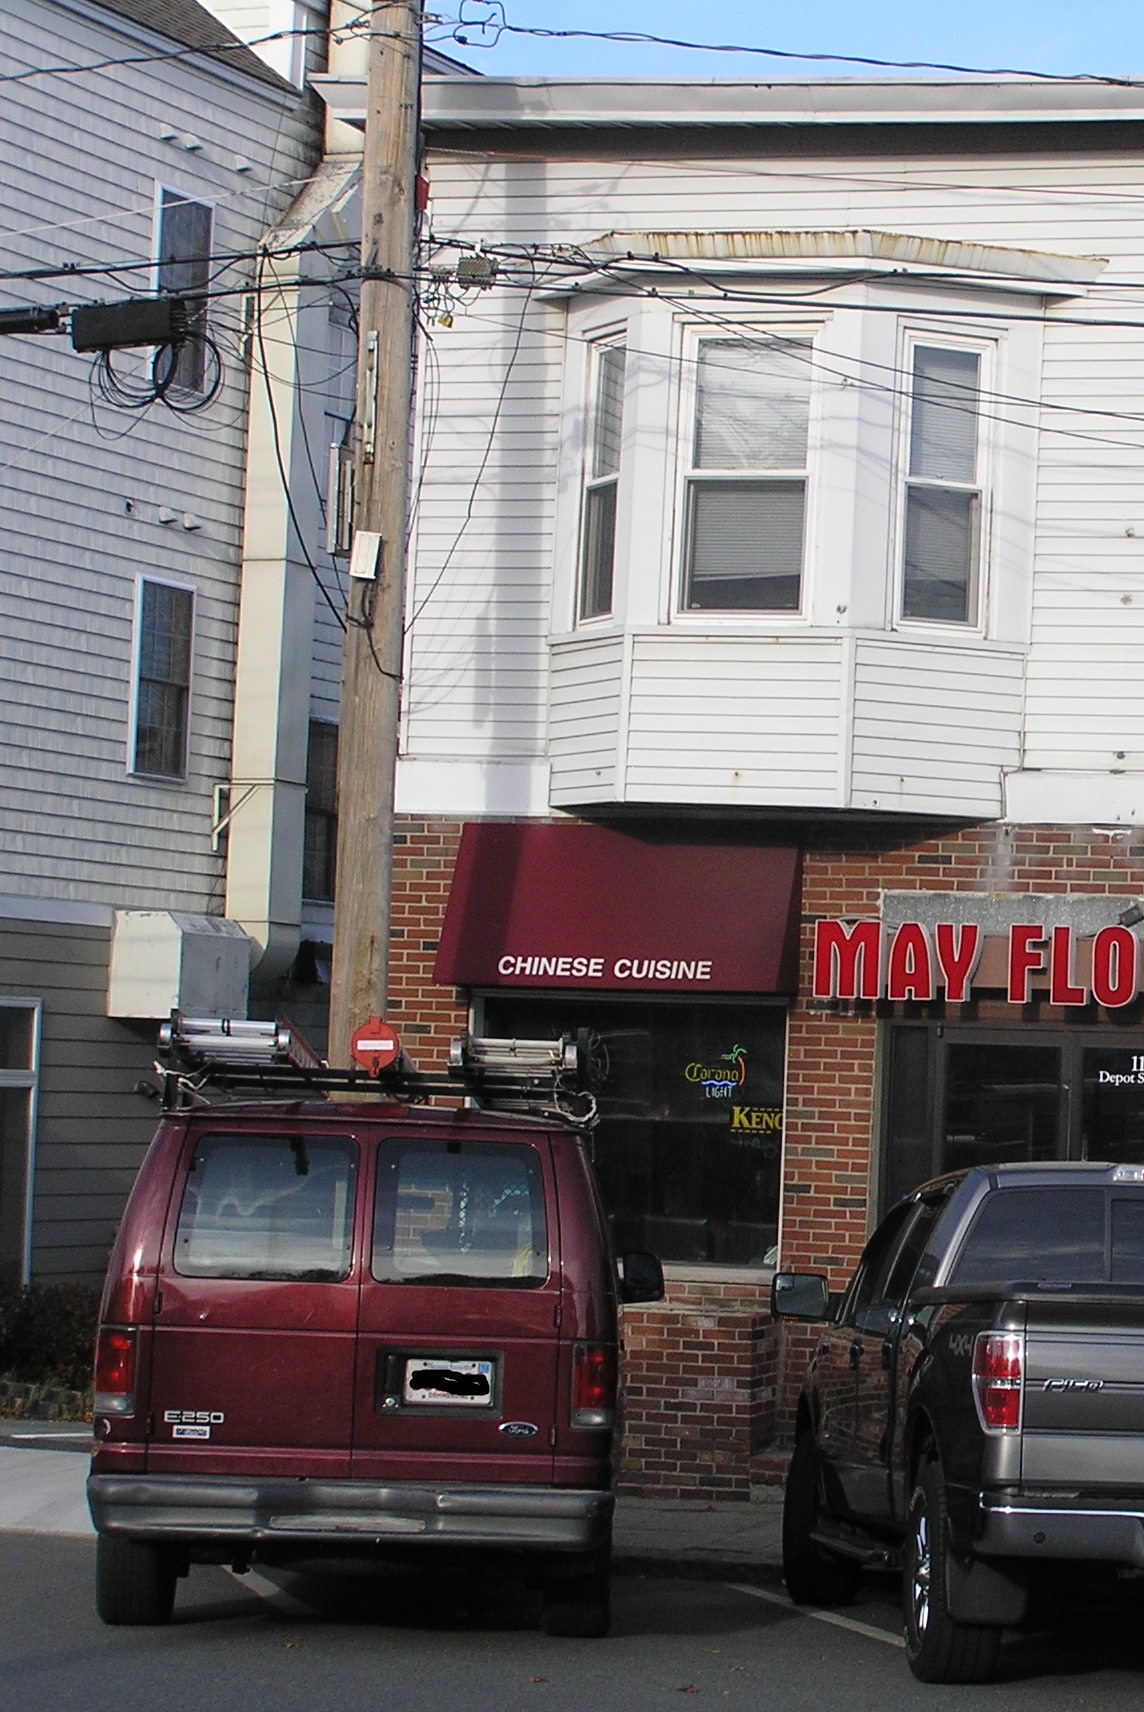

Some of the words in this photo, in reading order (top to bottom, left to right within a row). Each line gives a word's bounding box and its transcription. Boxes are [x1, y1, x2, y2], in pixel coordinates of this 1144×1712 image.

[498, 955, 604, 978] CHINESE
[613, 959, 712, 980] CUISINE
[813, 919, 981, 1002] MAY
[684, 1062, 739, 1083] Corona
[1099, 1070, 1135, 1087] Depot
[705, 1086, 733, 1099] LIGHT
